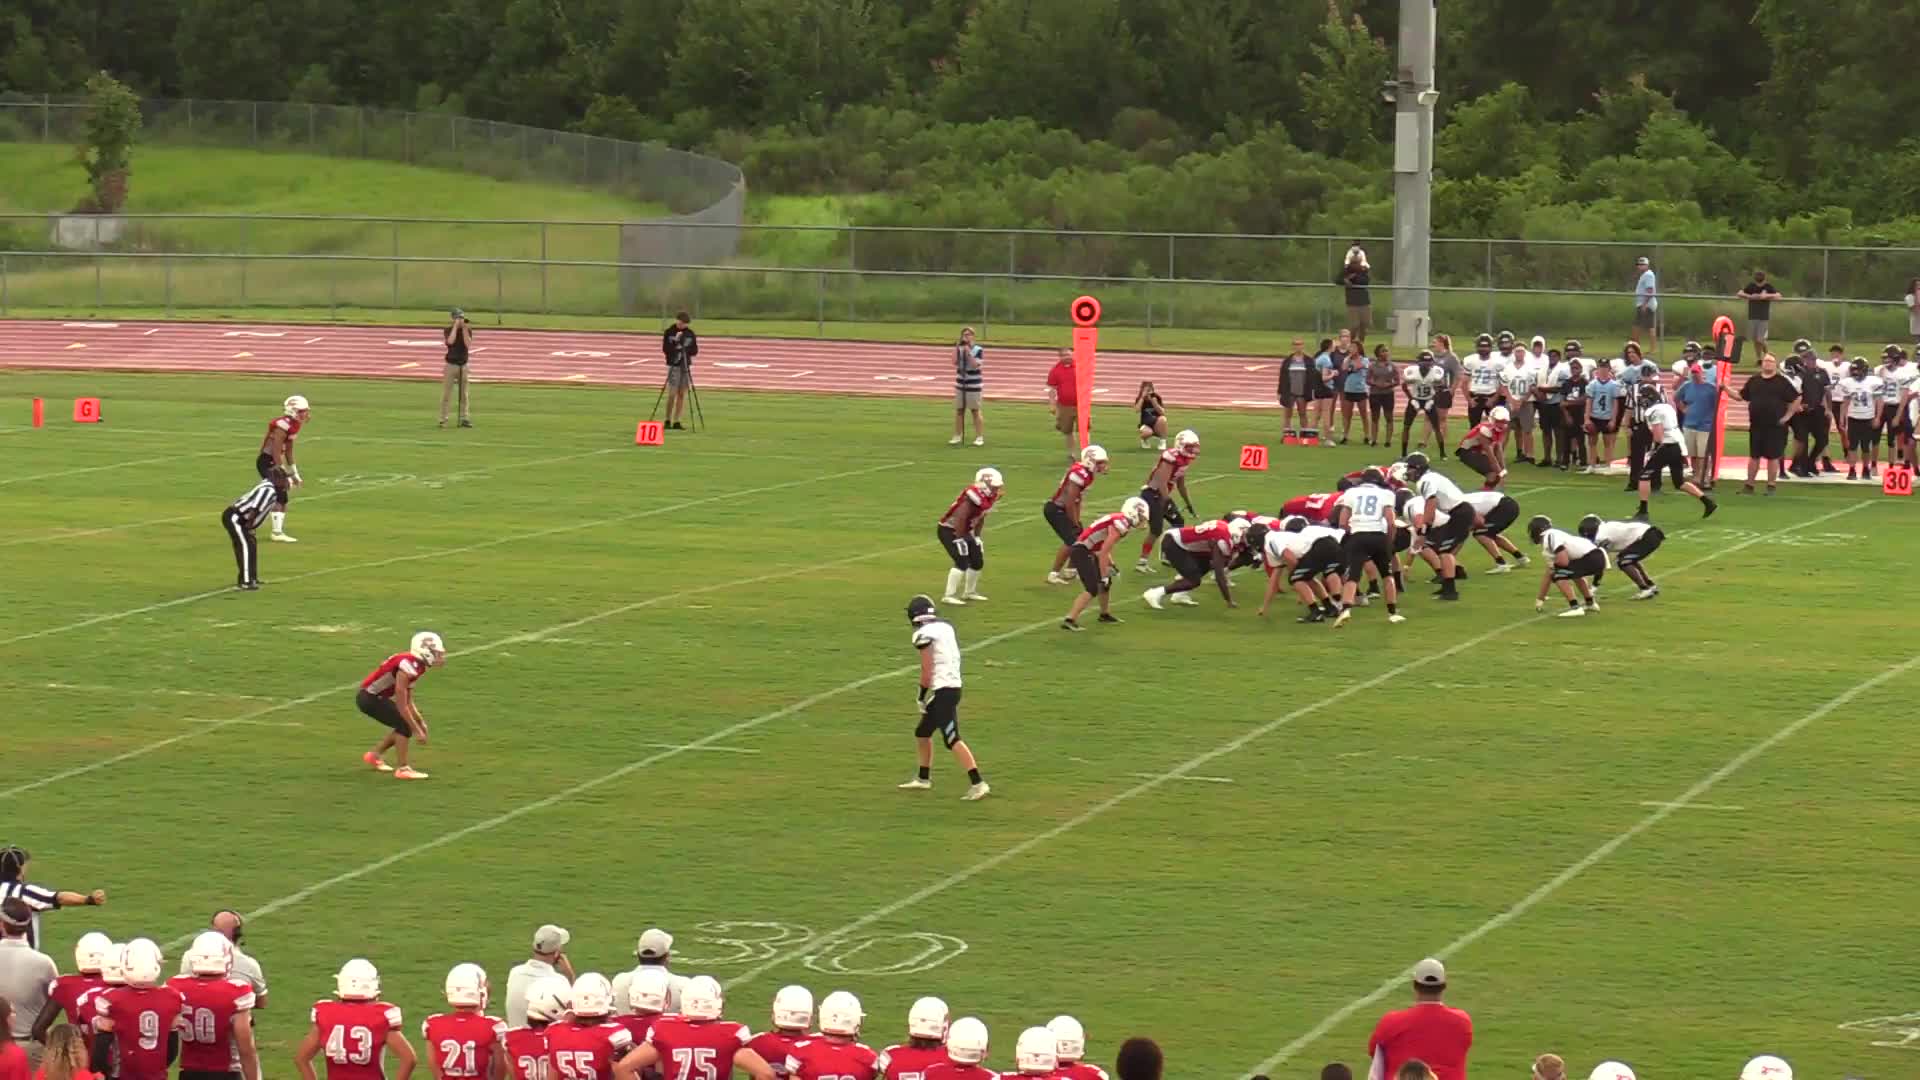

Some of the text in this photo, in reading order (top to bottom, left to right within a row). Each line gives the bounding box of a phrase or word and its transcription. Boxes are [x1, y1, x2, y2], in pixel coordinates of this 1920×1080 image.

[1509, 379, 1527, 397] 40
[82, 401, 92, 417] G
[1598, 395, 1607, 412] 4
[641, 425, 657, 441] 10
[1243, 448, 1262, 466] 20
[1886, 472, 1908, 490] 30
[1356, 495, 1377, 516] 18
[668, 920, 968, 977] 30
[138, 1010, 160, 1050] 9
[178, 1003, 216, 1044] 50
[325, 1025, 373, 1065] 43
[440, 1039, 478, 1077] 21
[556, 1051, 595, 1080] 55
[672, 1048, 718, 1080] 75
